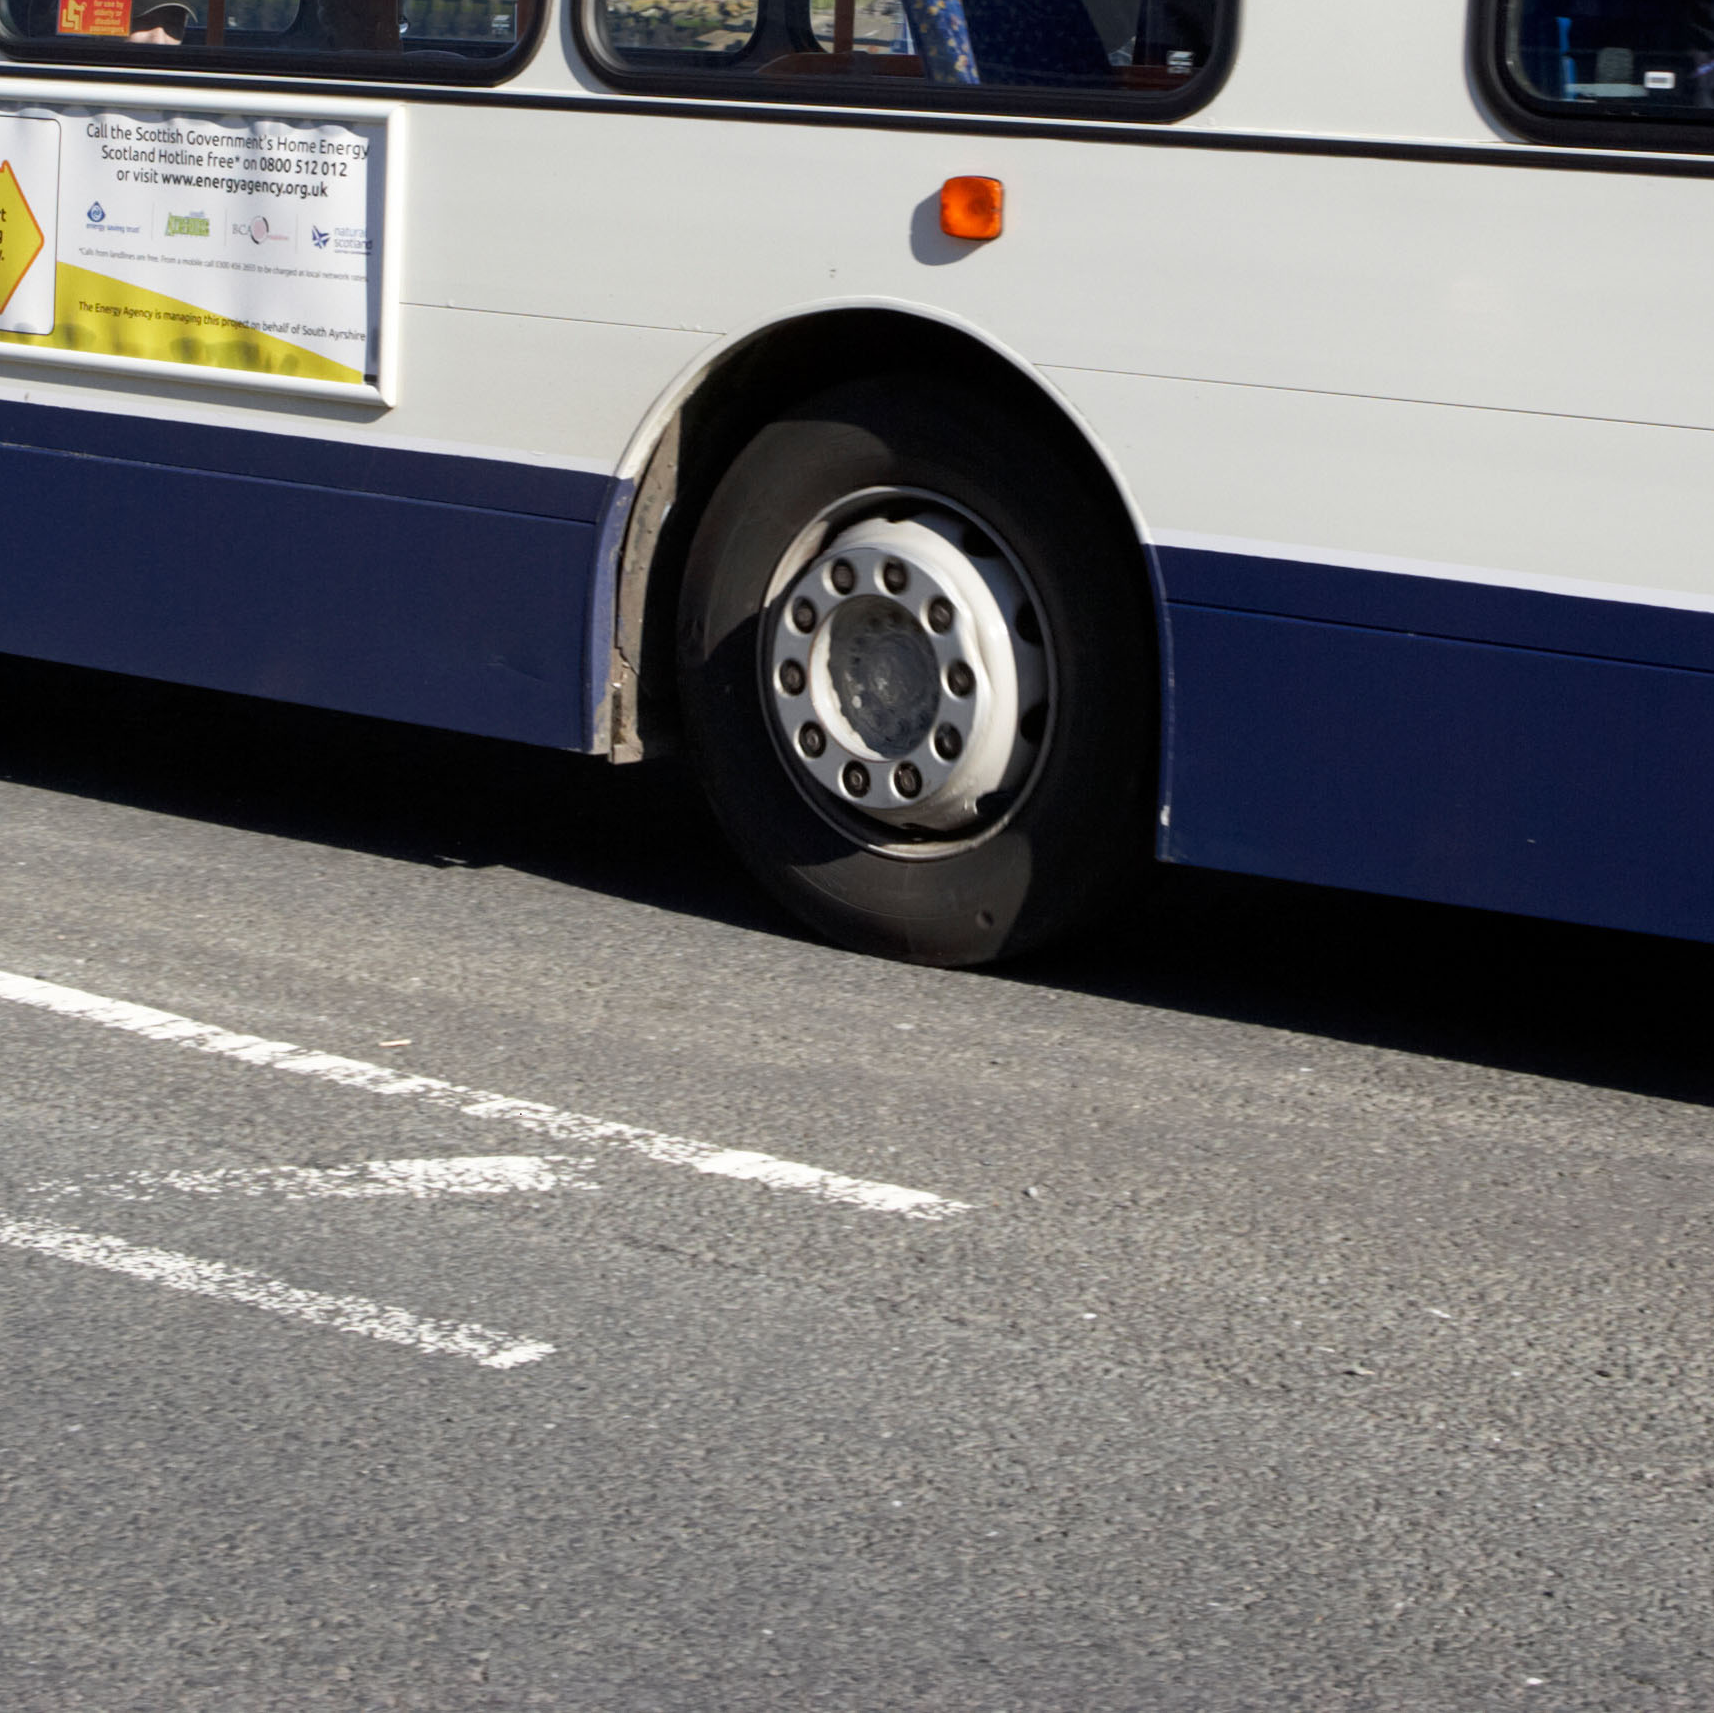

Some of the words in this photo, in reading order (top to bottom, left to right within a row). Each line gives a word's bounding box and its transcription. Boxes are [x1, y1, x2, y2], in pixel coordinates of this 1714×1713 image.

[87, 122, 107, 138] Call
[111, 125, 132, 140] the
[135, 126, 183, 144] Scottish
[187, 130, 273, 150] Government's
[277, 136, 316, 154] Home
[319, 139, 370, 160] Energy
[101, 144, 156, 163] Scotland
[159, 148, 203, 166] Hotline
[243, 159, 257, 170] on
[259, 157, 292, 173] 0800
[295, 159, 318, 175] 512
[321, 161, 348, 177] 012
[116, 169, 130, 181] or
[133, 167, 159, 183] visit
[161, 172, 328, 199] www.energyagency.org.uk
[79, 301, 93, 312] The
[95, 303, 122, 317] Energy
[123, 306, 153, 320] Agency
[155, 309, 161, 319] is
[163, 311, 201, 326] managing
[203, 314, 219, 326] this
[221, 317, 250, 330] project
[251, 322, 260, 330] on
[262, 321, 290, 332] behalf
[291, 324, 300, 333] of
[302, 325, 327, 337] South
[328, 328, 366, 341] Ayrshire
